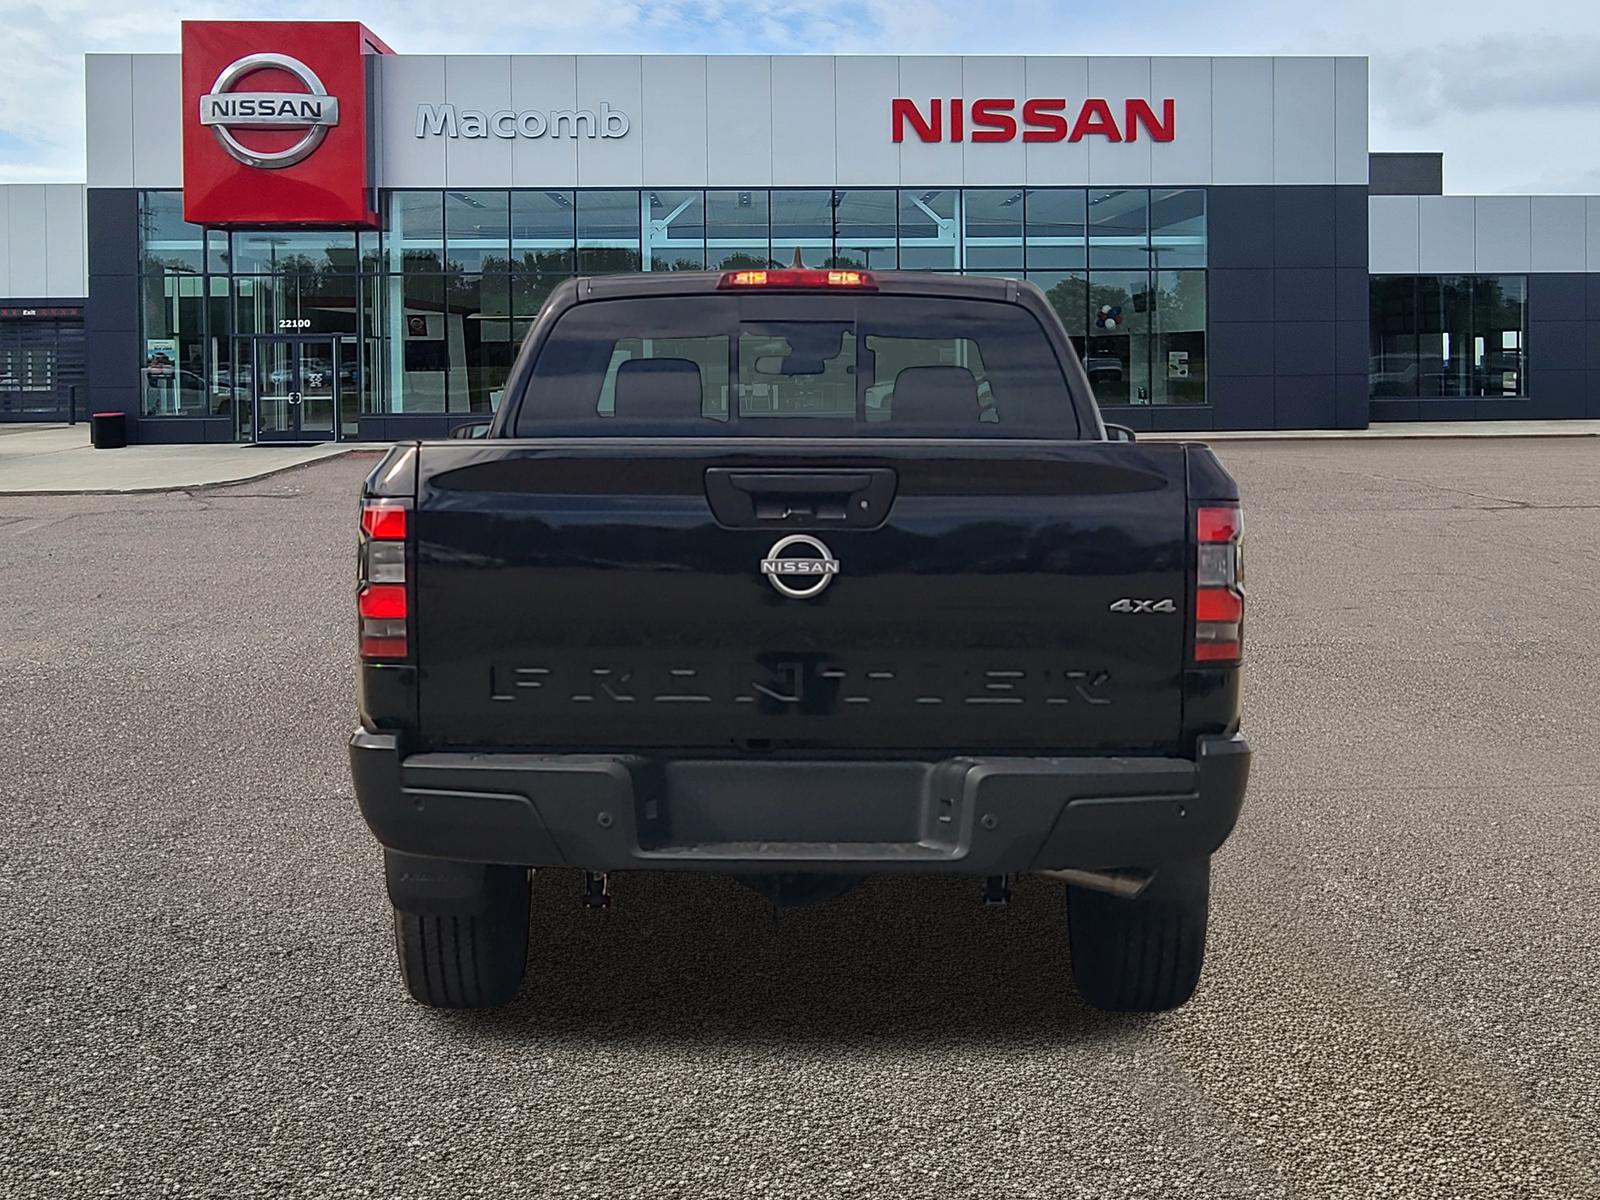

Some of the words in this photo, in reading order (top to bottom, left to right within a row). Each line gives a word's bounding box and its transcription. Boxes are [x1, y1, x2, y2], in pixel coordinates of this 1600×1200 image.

[211, 97, 323, 118] NISSAN
[415, 102, 630, 140] Macomb
[892, 98, 1177, 143] NISSAN
[279, 319, 311, 328] 22100
[762, 561, 838, 573] NISSAN
